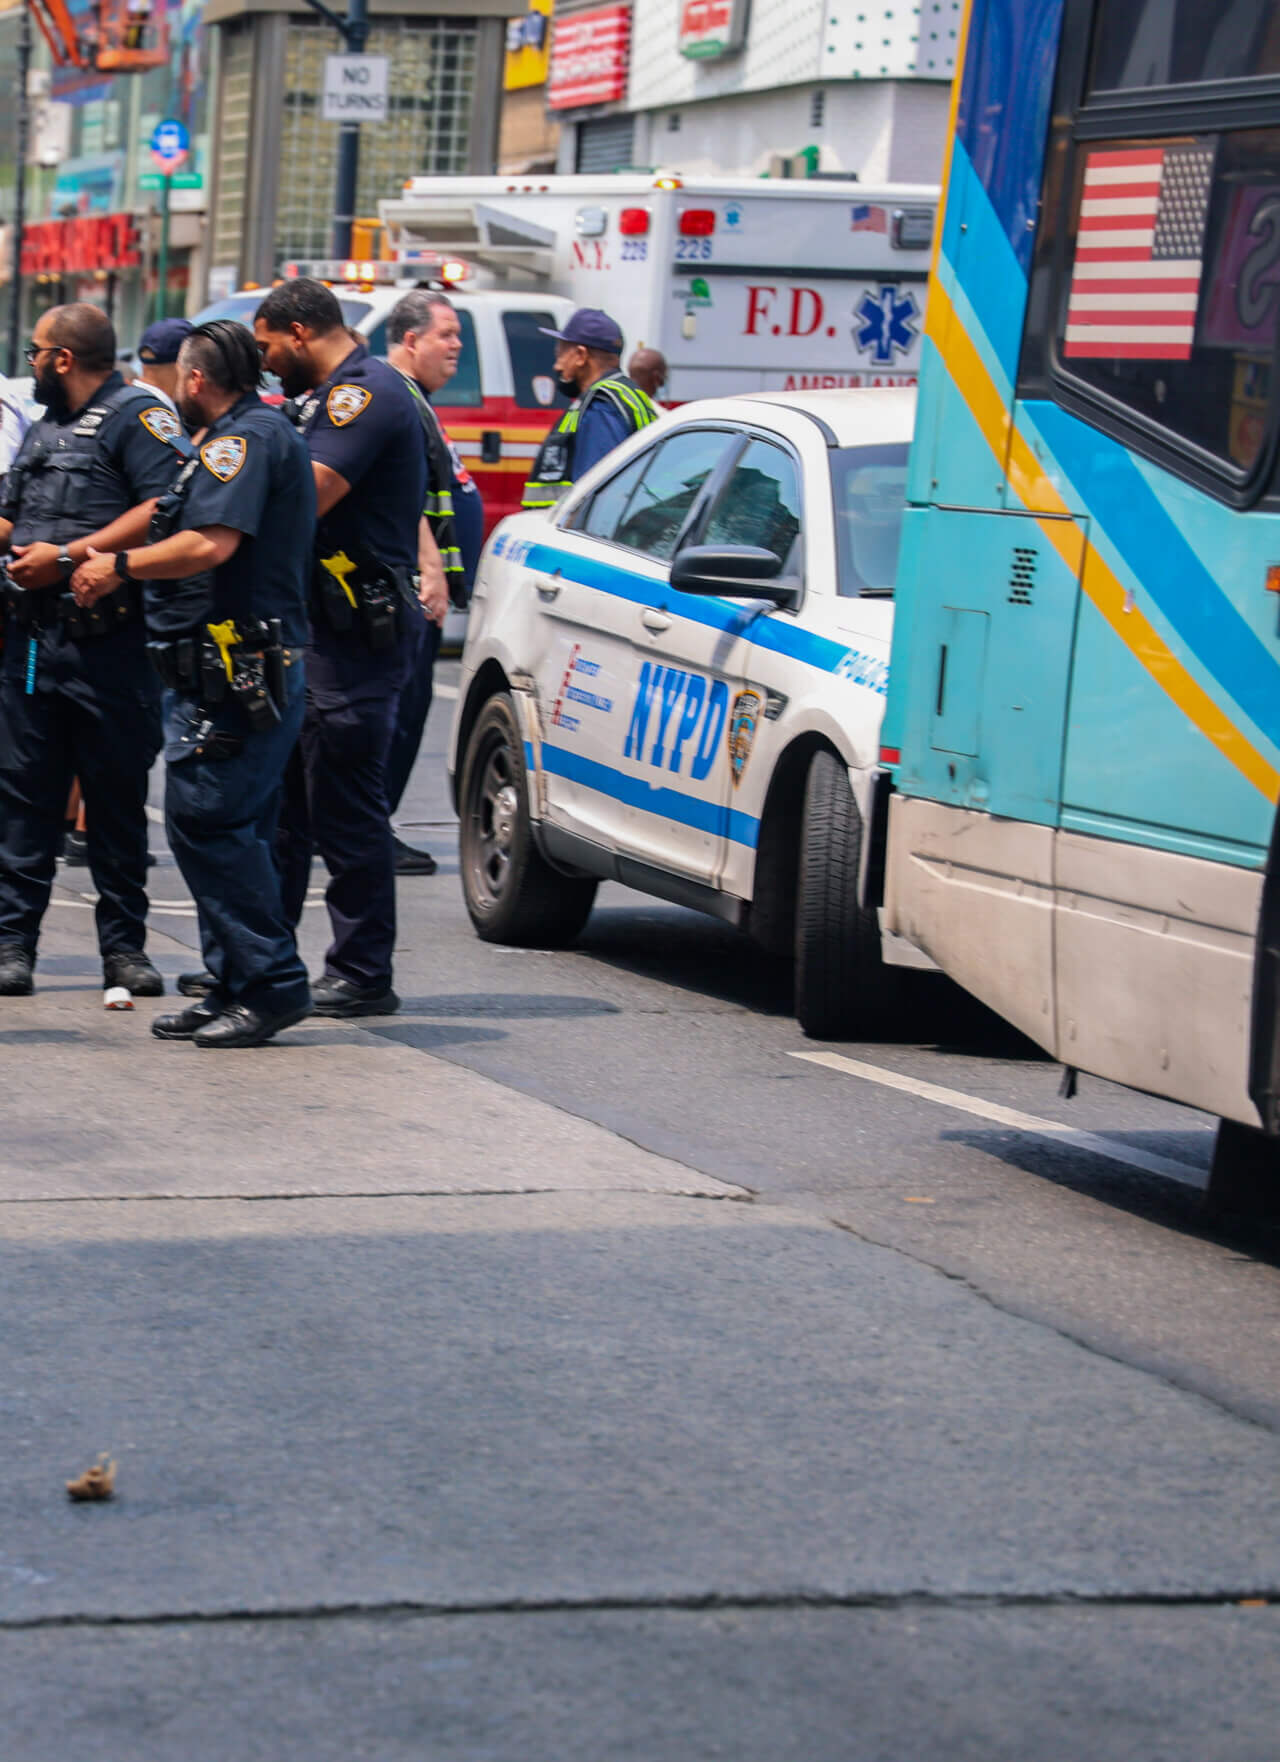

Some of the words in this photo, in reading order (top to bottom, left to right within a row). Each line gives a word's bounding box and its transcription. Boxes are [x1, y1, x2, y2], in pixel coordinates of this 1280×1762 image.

[342, 66, 371, 85] NO
[327, 92, 385, 110] TURNS
[568, 240, 612, 271] N.Y.
[675, 238, 713, 260] 228
[742, 285, 838, 338] F.D.
[623, 660, 729, 781] NYPD
